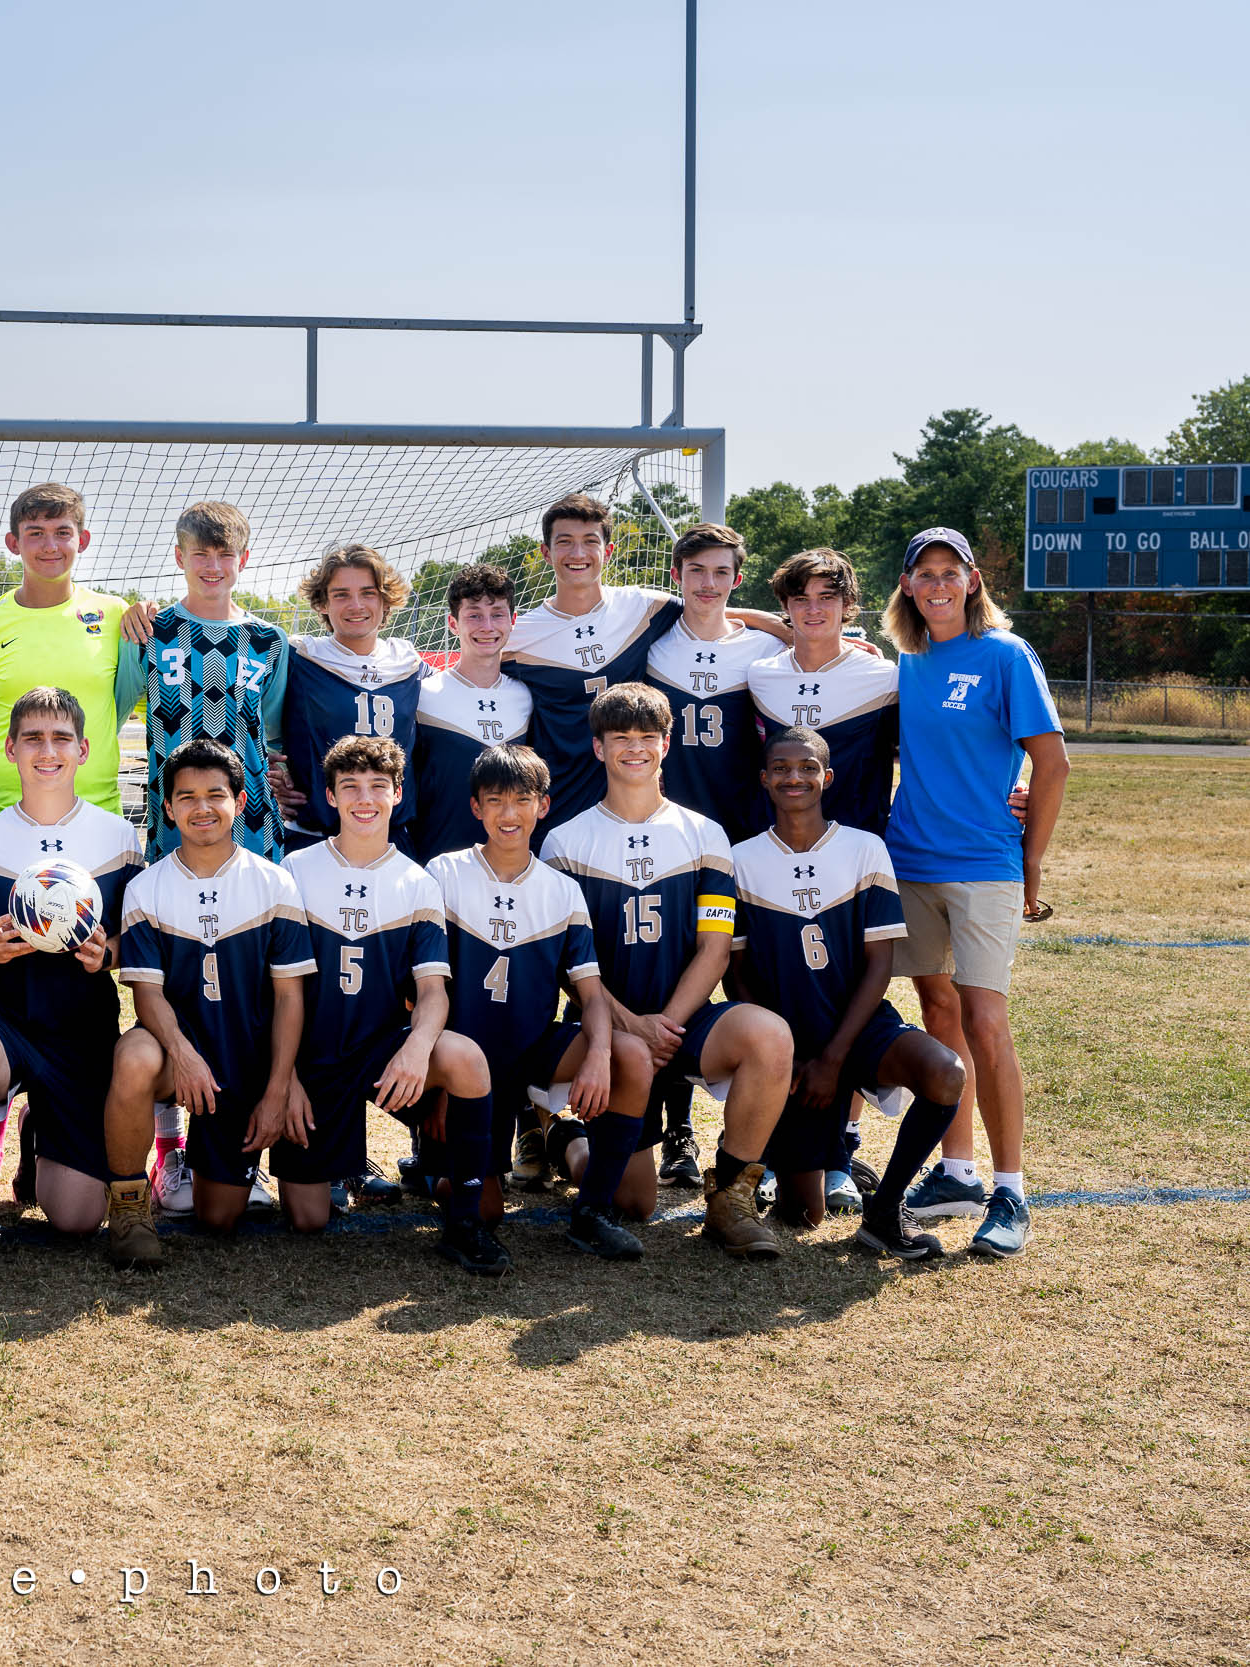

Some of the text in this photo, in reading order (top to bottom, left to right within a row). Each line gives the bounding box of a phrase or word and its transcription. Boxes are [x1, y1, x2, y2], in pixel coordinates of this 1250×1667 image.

[1031, 470, 1098, 488] COUGARS
[1032, 533, 1082, 550] DOWN
[1105, 532, 1161, 550] TO GO
[1190, 531, 1250, 549] BALL O
[161, 647, 186, 686] 3
[575, 644, 606, 667] TC
[690, 671, 719, 692] TC
[354, 691, 395, 736] 18
[681, 703, 724, 747] 13
[792, 704, 821, 726] TC
[477, 719, 504, 741] TC
[625, 858, 654, 882] TC
[791, 888, 822, 912] TC
[339, 907, 369, 933] TC
[622, 894, 663, 945] 15
[705, 908, 733, 919] CAPTA
[199, 914, 219, 939] TC
[488, 918, 517, 944] TC
[801, 923, 830, 970] 6
[202, 952, 222, 1002] 9
[339, 946, 364, 995] 5
[483, 956, 511, 1003] 4
